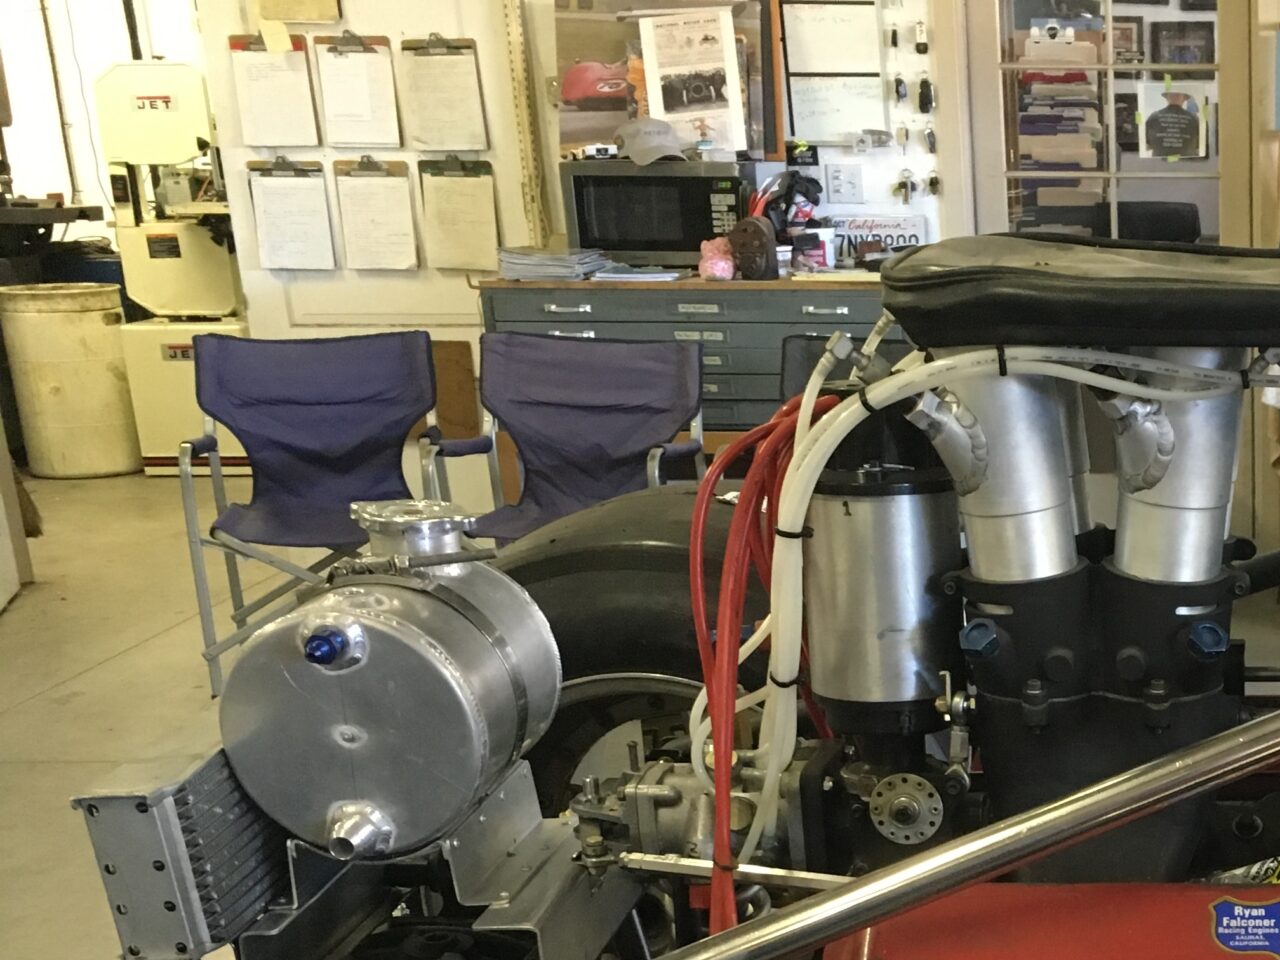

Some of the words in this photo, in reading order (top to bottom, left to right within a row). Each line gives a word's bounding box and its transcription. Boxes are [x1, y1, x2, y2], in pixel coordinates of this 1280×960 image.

[137, 101, 171, 109] JET
[848, 219, 907, 233] California
[169, 351, 190, 359] JE
[1234, 906, 1266, 918] Ryan
[1222, 917, 1276, 927] Falconer
